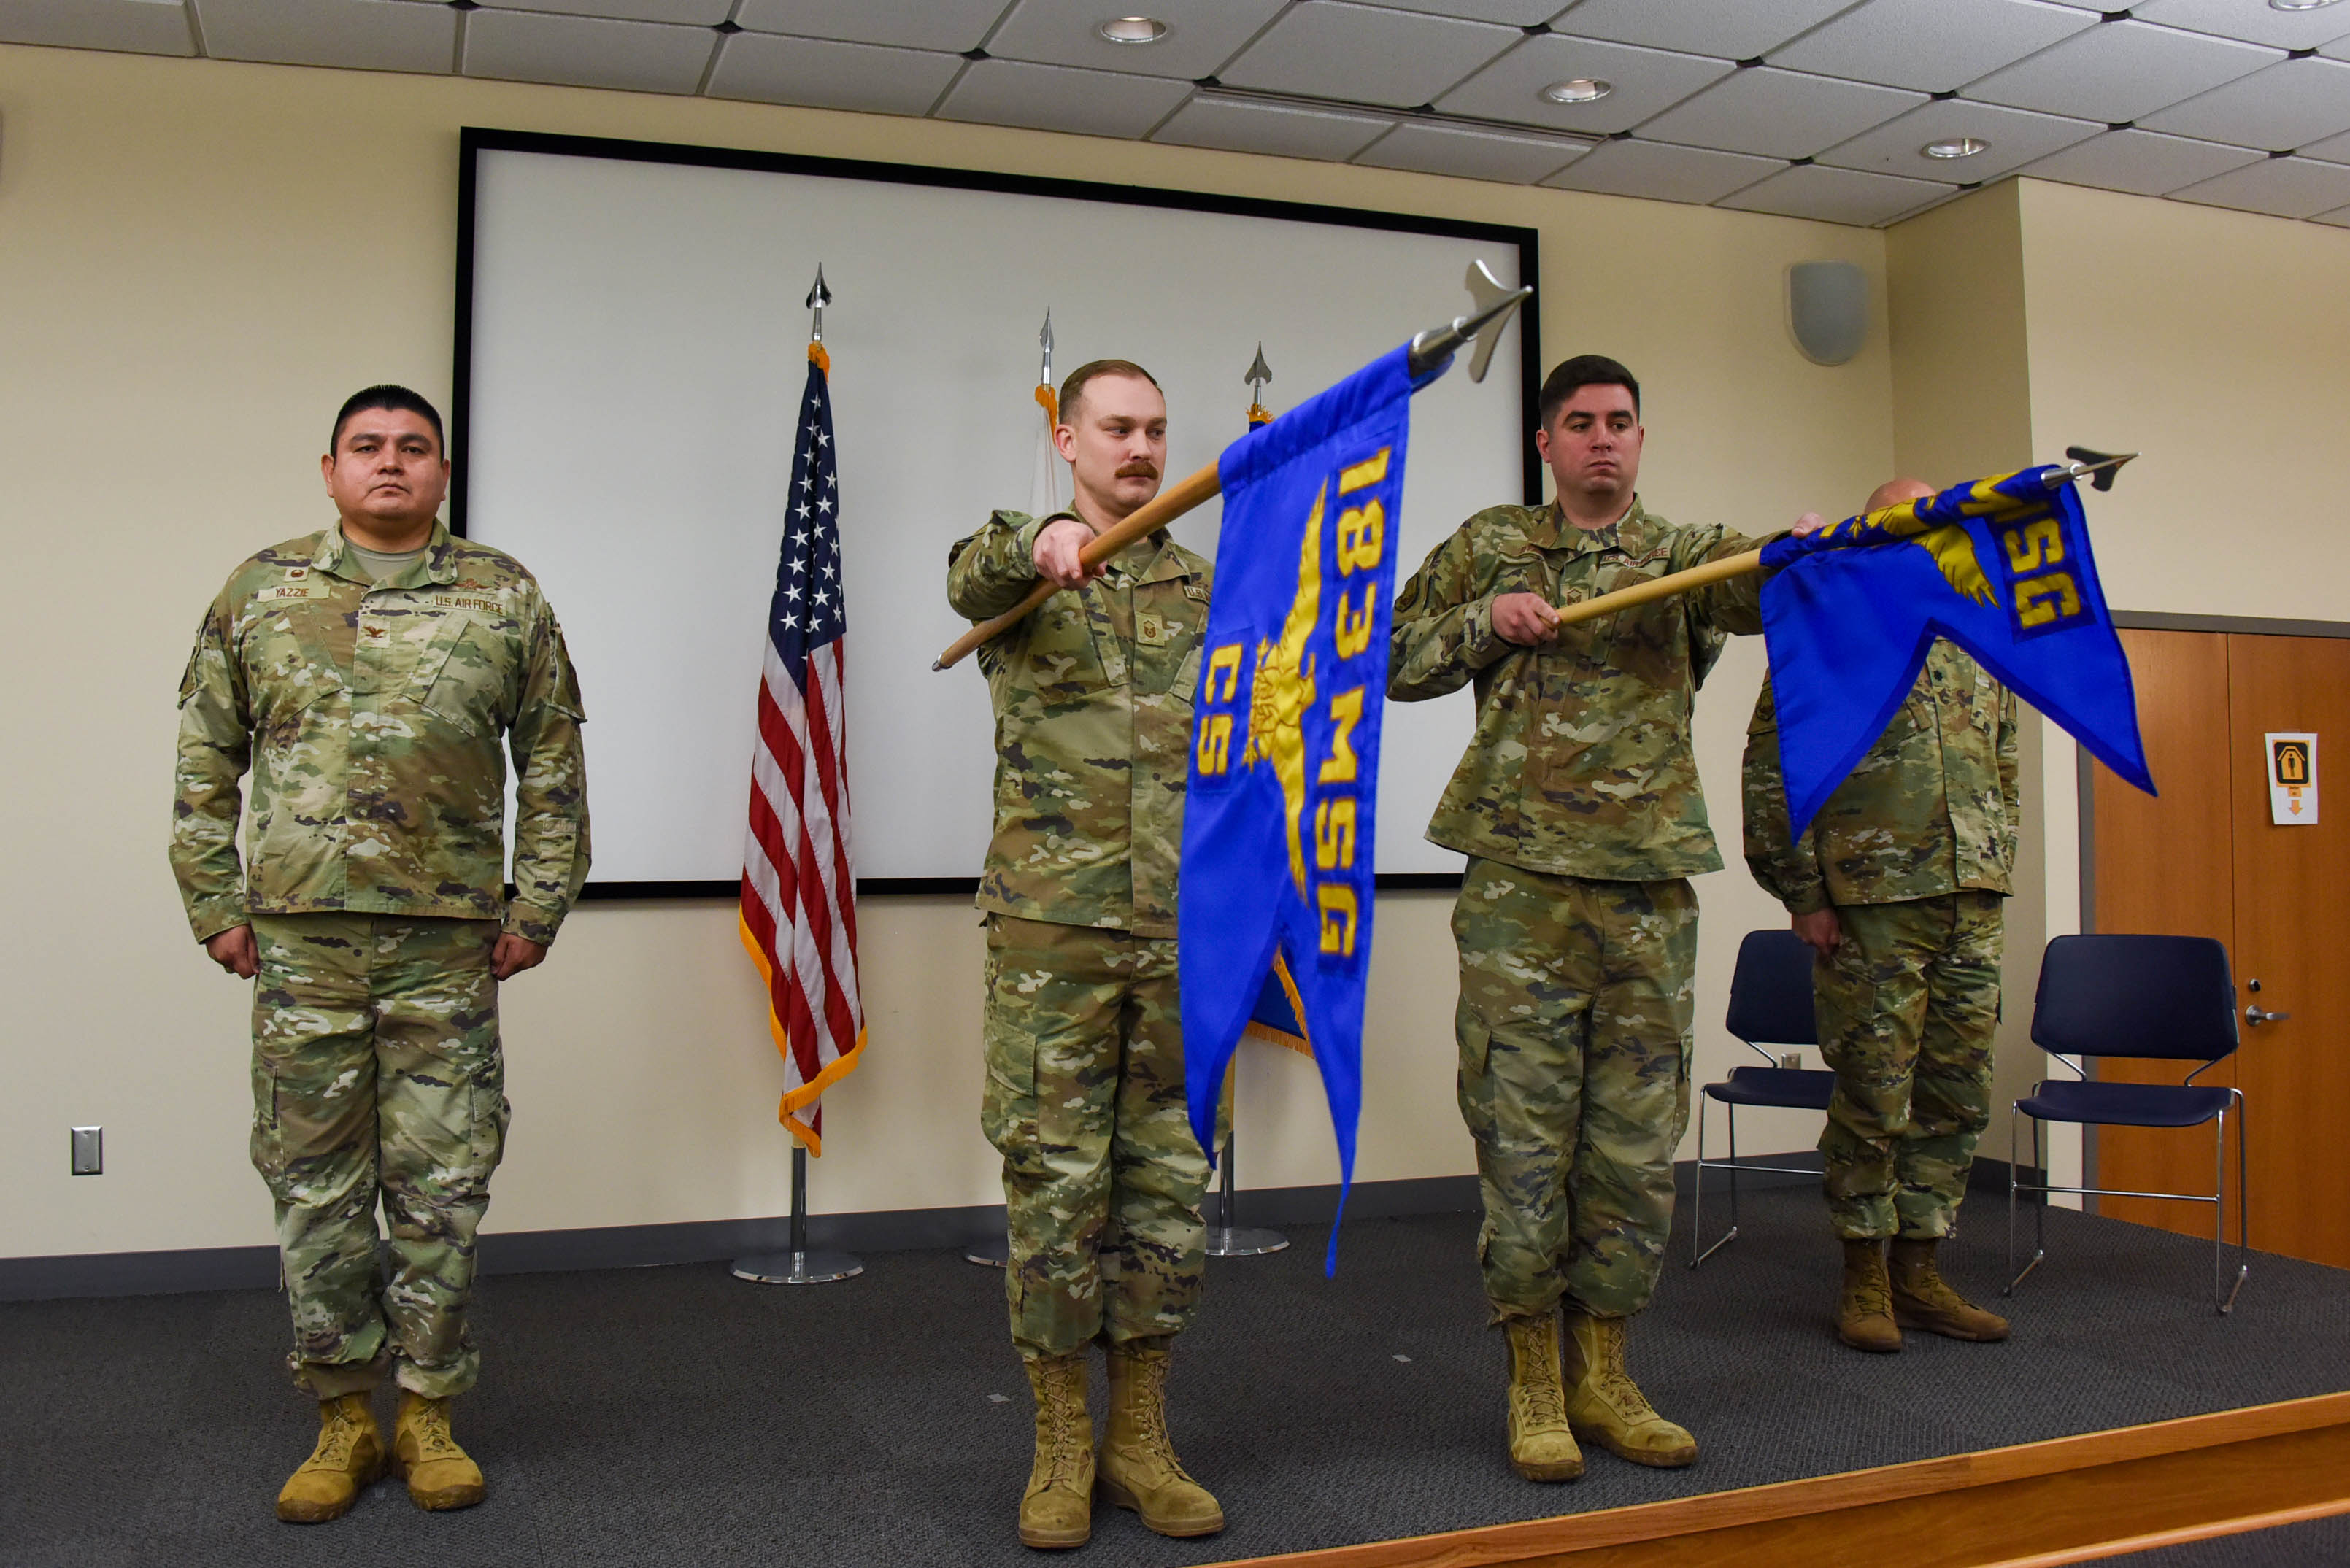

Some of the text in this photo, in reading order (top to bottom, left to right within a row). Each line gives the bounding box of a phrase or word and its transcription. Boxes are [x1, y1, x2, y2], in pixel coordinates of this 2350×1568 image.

[275, 587, 310, 598] YAZZIE
[435, 595, 504, 614] U.S. AIR FORCE
[1198, 644, 1242, 775] CS
[1316, 447, 1390, 957] 183 MSG
